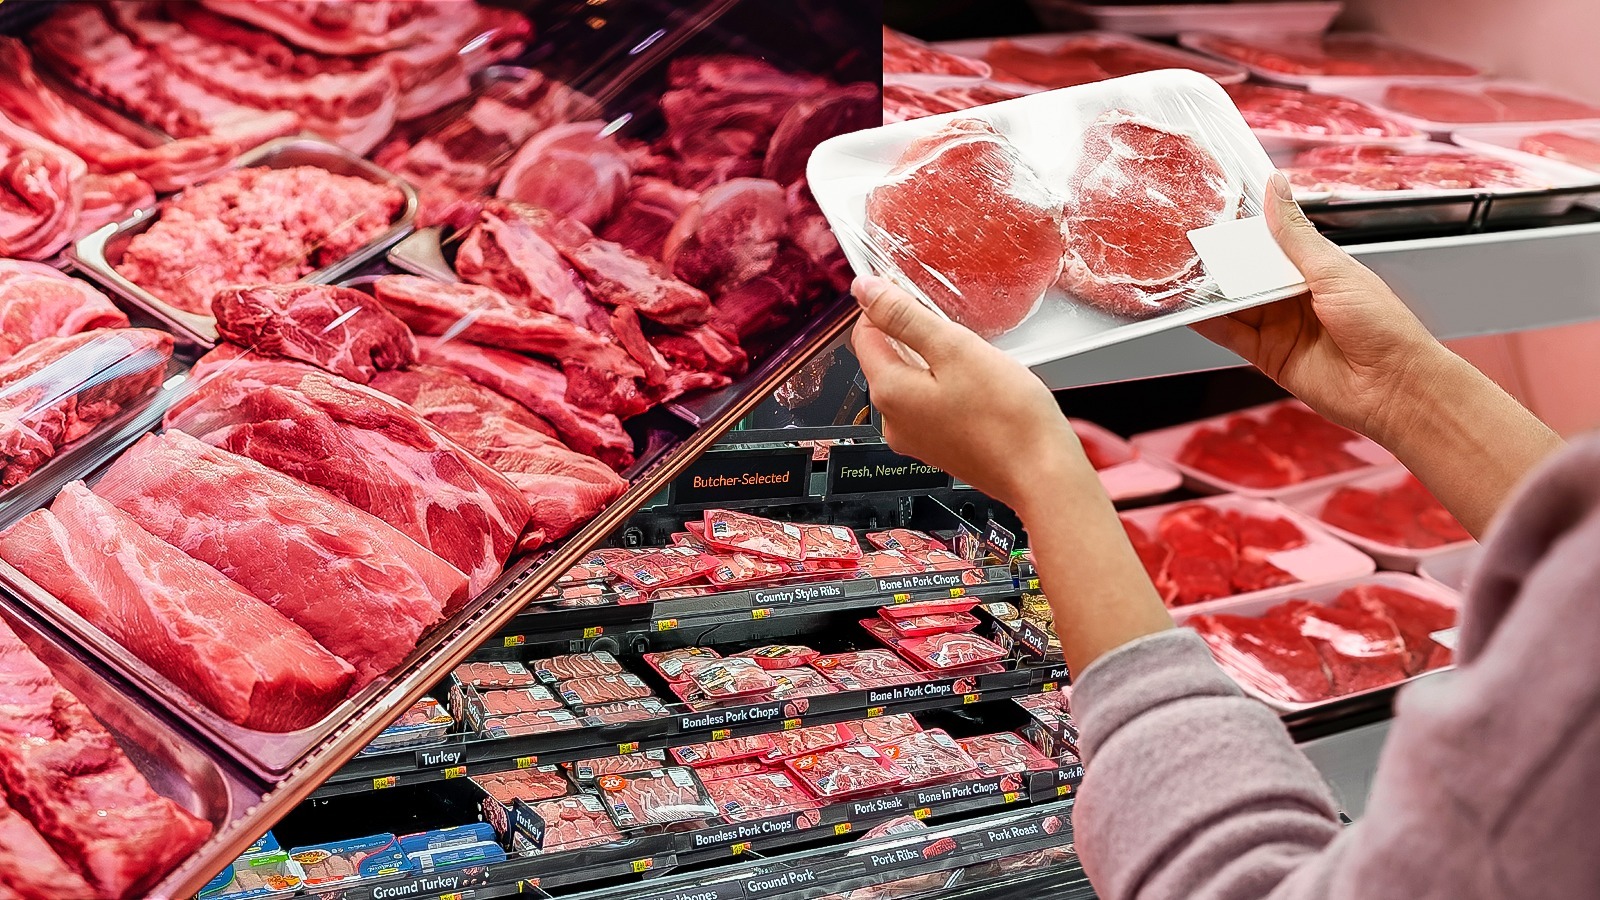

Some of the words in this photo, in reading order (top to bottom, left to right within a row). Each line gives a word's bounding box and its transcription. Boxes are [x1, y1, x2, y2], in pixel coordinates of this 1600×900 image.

[693, 471, 790, 488] Butcher-Selected
[840, 466, 873, 479] Fresh,
[875, 464, 908, 477] Never
[989, 529, 1009, 550] Pork
[879, 580, 902, 590] Bone
[903, 578, 912, 588] In
[912, 576, 933, 587] Pork
[933, 574, 960, 586] Chops
[755, 592, 794, 604] Country
[795, 588, 819, 601] Style
[819, 586, 841, 598] Ribs
[1024, 628, 1043, 650] Pork
[1050, 668, 1069, 679] Pork
[870, 690, 893, 702] Bone
[894, 689, 902, 698] In
[903, 686, 924, 698] Pork
[924, 683, 951, 696] Chops
[682, 712, 724, 729] Boneless
[725, 710, 747, 725] Pork
[749, 707, 779, 720] Chops
[421, 751, 461, 765] Turkey
[1058, 768, 1076, 780] Pork
[918, 791, 942, 804] Bone
[943, 789, 951, 800] In
[952, 787, 973, 799] Pork
[973, 783, 999, 796] Chops
[854, 802, 875, 815] Pork
[876, 798, 903, 812] Steak
[515, 808, 542, 840] Turkey
[695, 826, 738, 846] Boneless
[739, 825, 761, 841] Pork
[761, 819, 791, 835] Chops
[988, 829, 1011, 842] Pork
[1012, 823, 1038, 837] Roast
[871, 852, 896, 866] Pork
[897, 848, 919, 863] Ribs
[373, 880, 419, 899] Ground
[419, 876, 459, 889] Turkey
[747, 874, 788, 892] Ground
[789, 868, 816, 885] Pork
